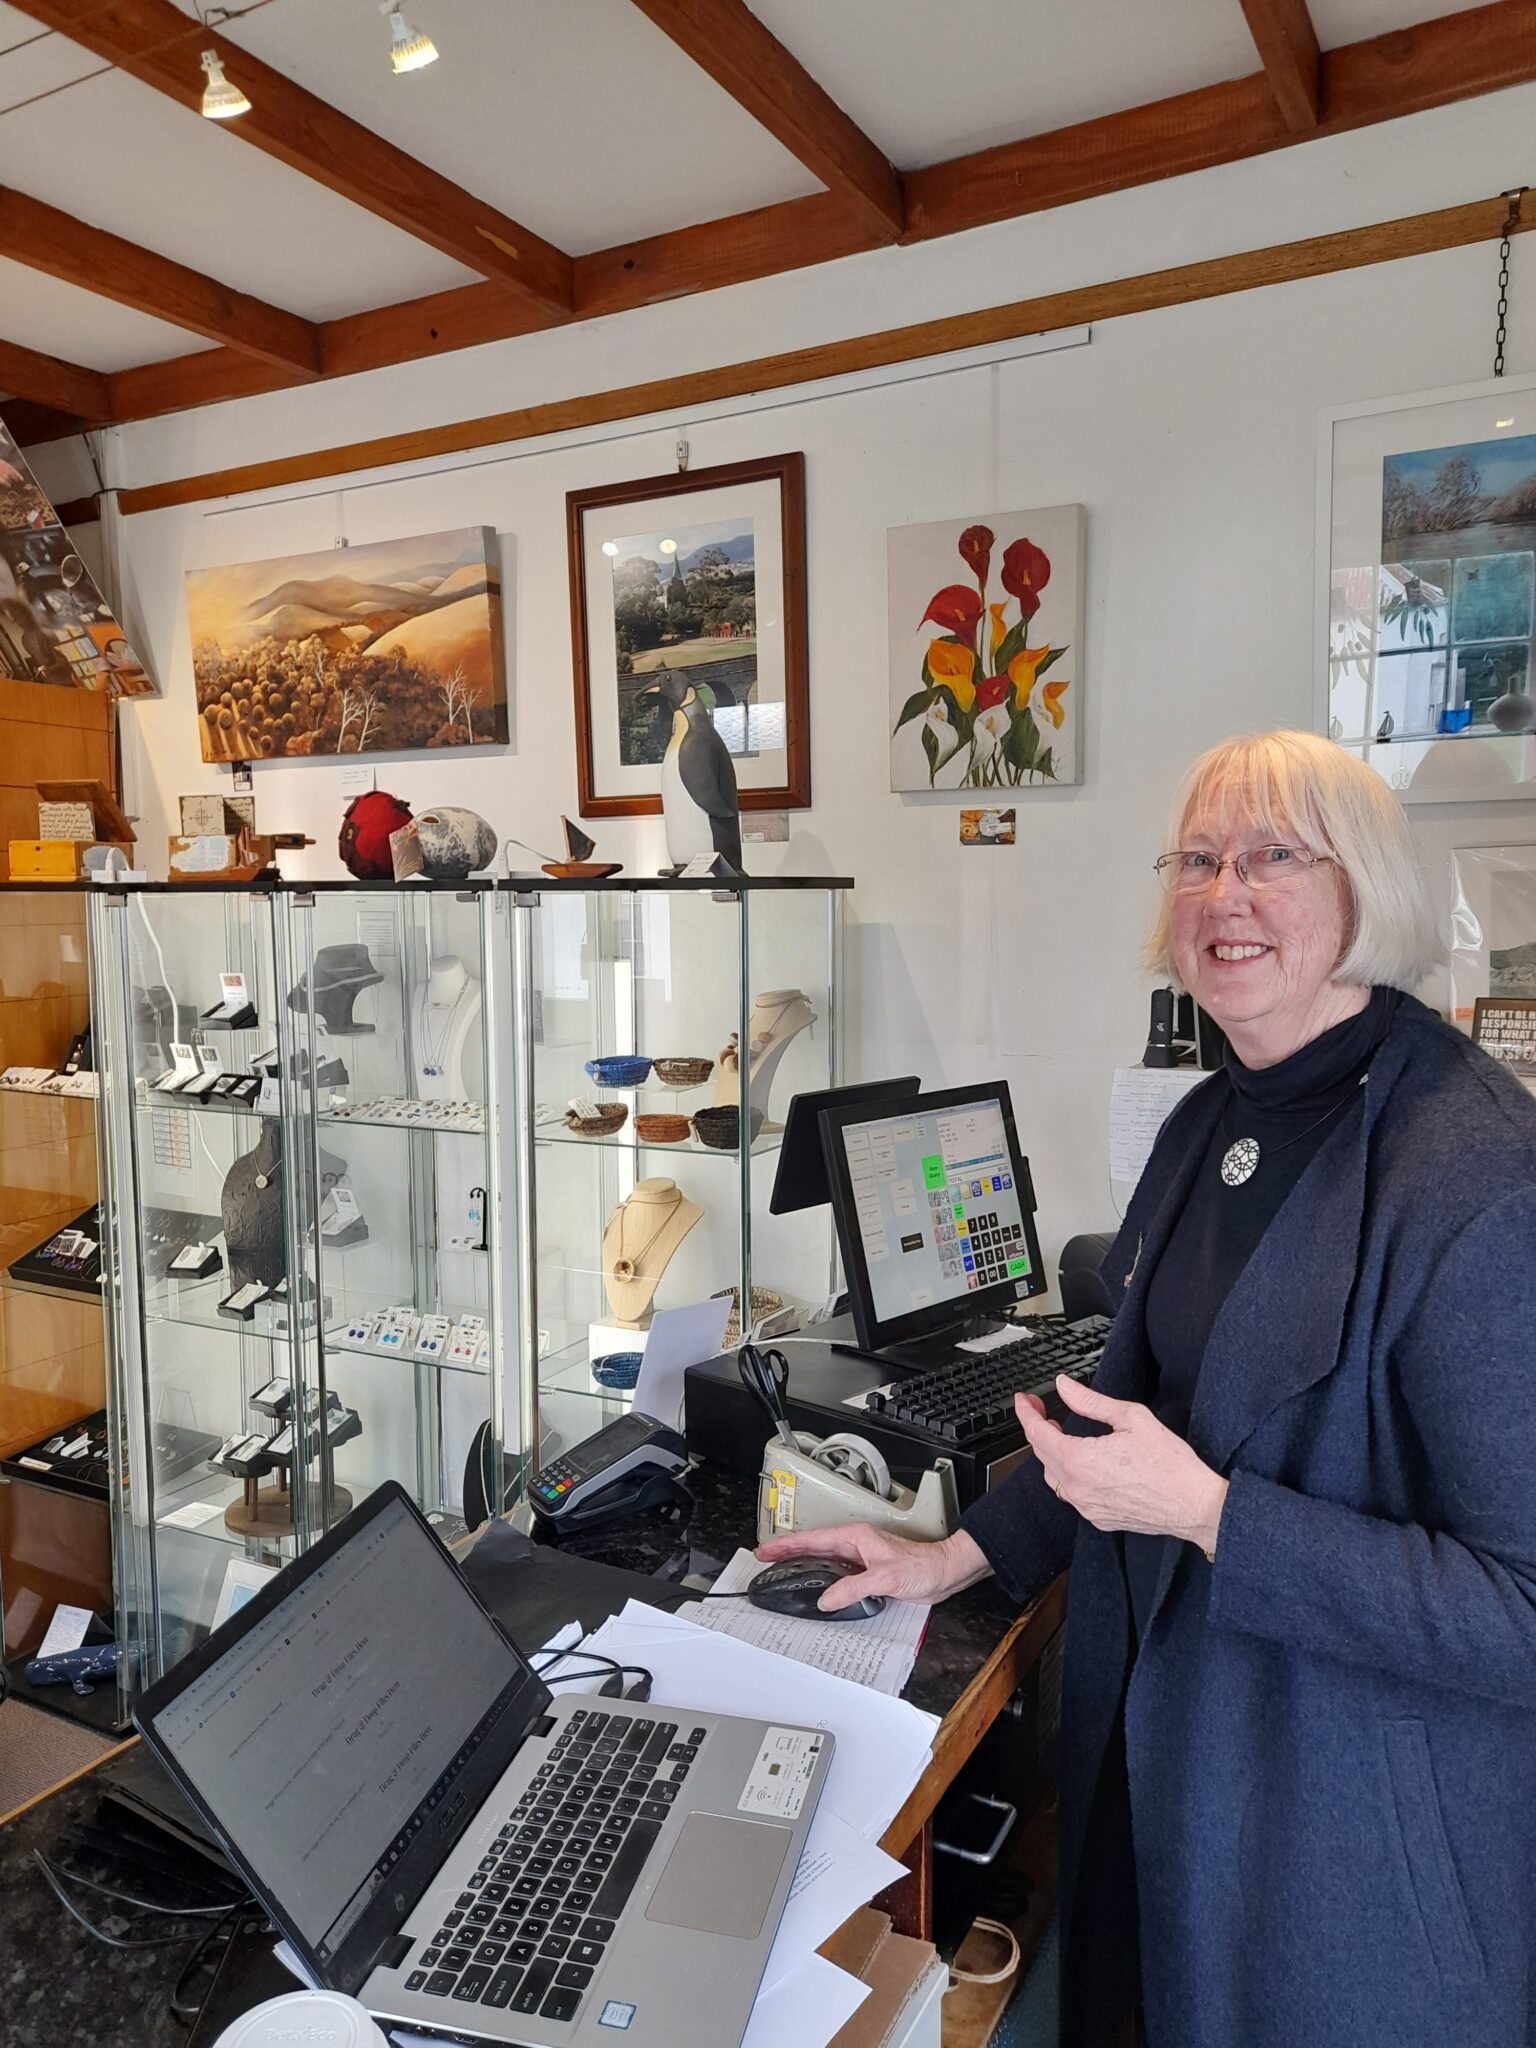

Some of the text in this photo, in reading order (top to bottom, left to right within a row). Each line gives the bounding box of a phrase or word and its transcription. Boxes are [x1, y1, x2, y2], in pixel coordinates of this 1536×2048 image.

[1487, 1009, 1514, 1019] CAN'T
[1515, 1010, 1528, 1020] BE
[1480, 1028, 1500, 1039] FOR
[1501, 1029, 1532, 1040] WHAT
[1010, 1261, 1025, 1271] CASH
[439, 1791, 468, 1839] ASUS
